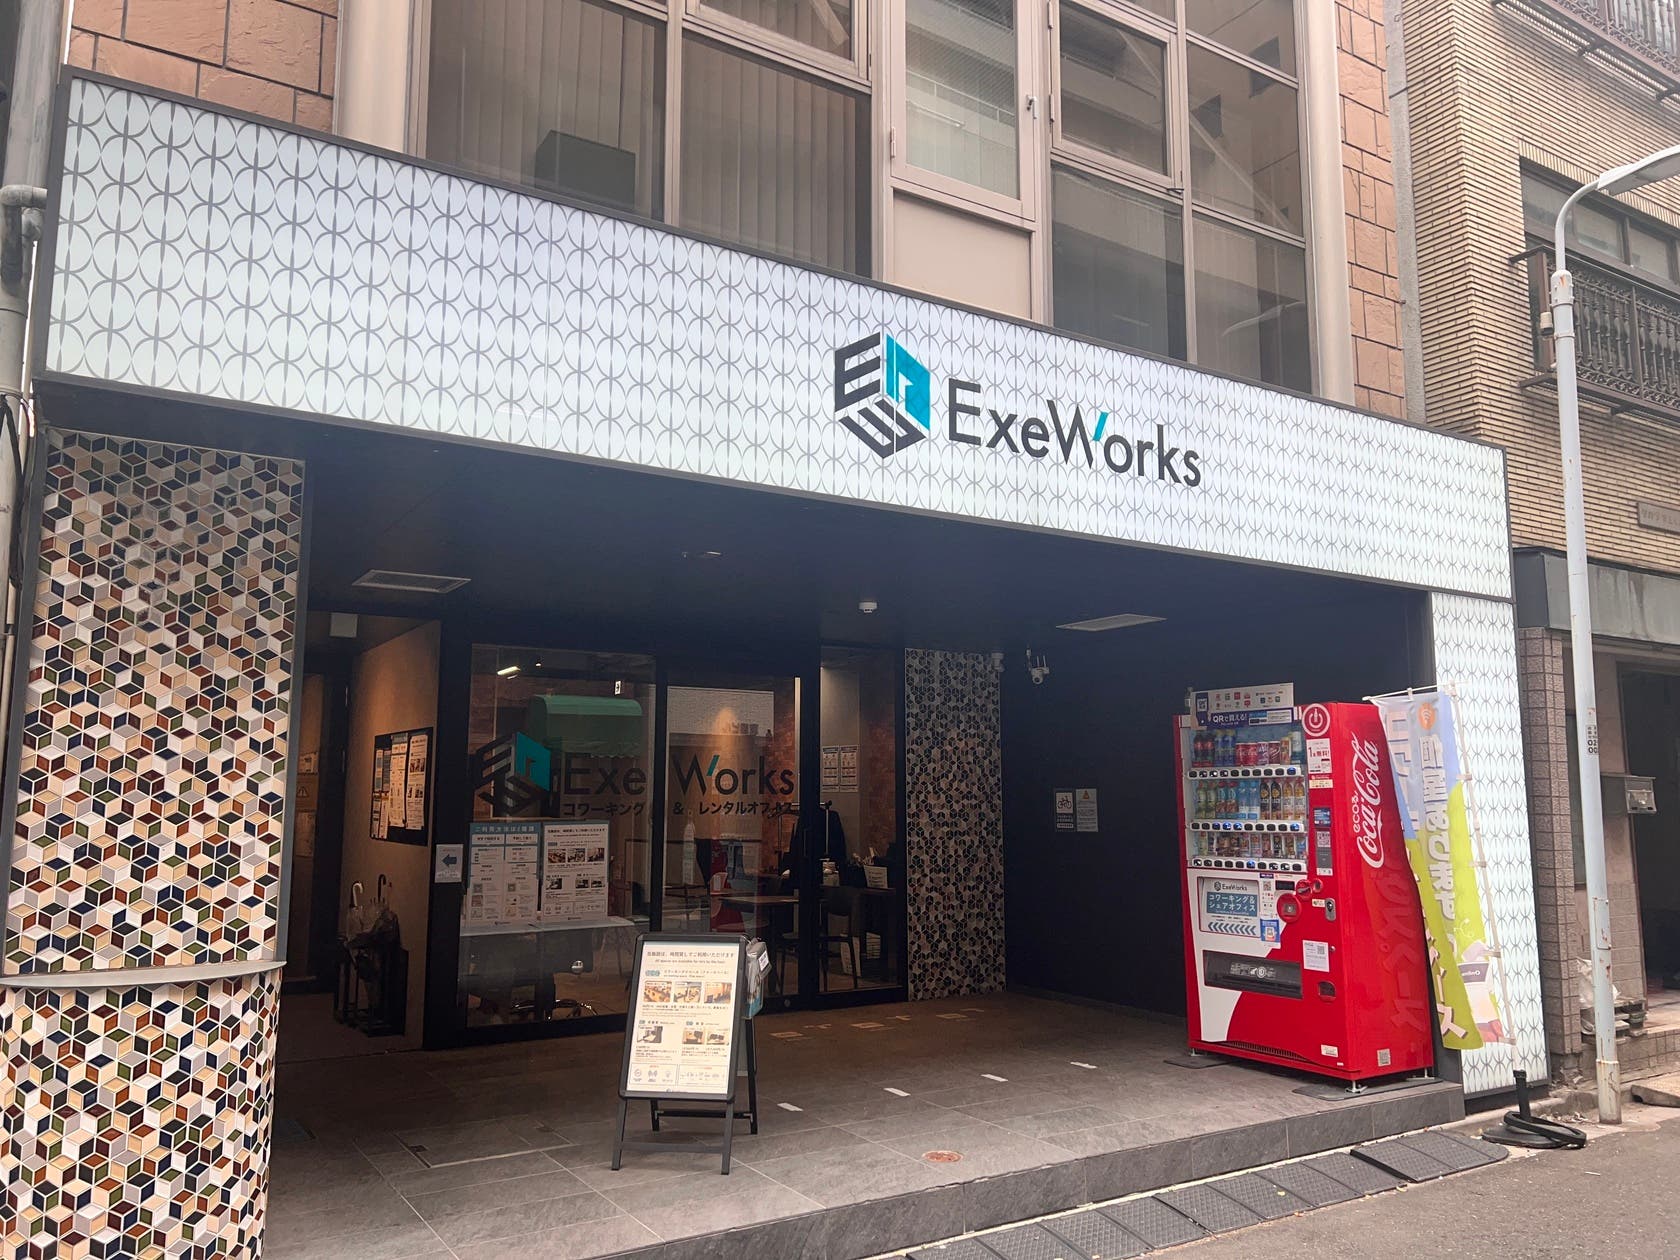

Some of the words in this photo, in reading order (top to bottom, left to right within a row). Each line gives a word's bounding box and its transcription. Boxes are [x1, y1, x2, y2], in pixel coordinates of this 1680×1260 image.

[948, 377, 1202, 488] ExeWorks
[673, 754, 795, 796] Works
[563, 801, 645, 818] コワーキング
[672, 801, 685, 815] &
[1351, 731, 1385, 869] Coca-Cola
[1222, 883, 1248, 891] ExeWorks
[1208, 901, 1256, 912] シェアオフィス
